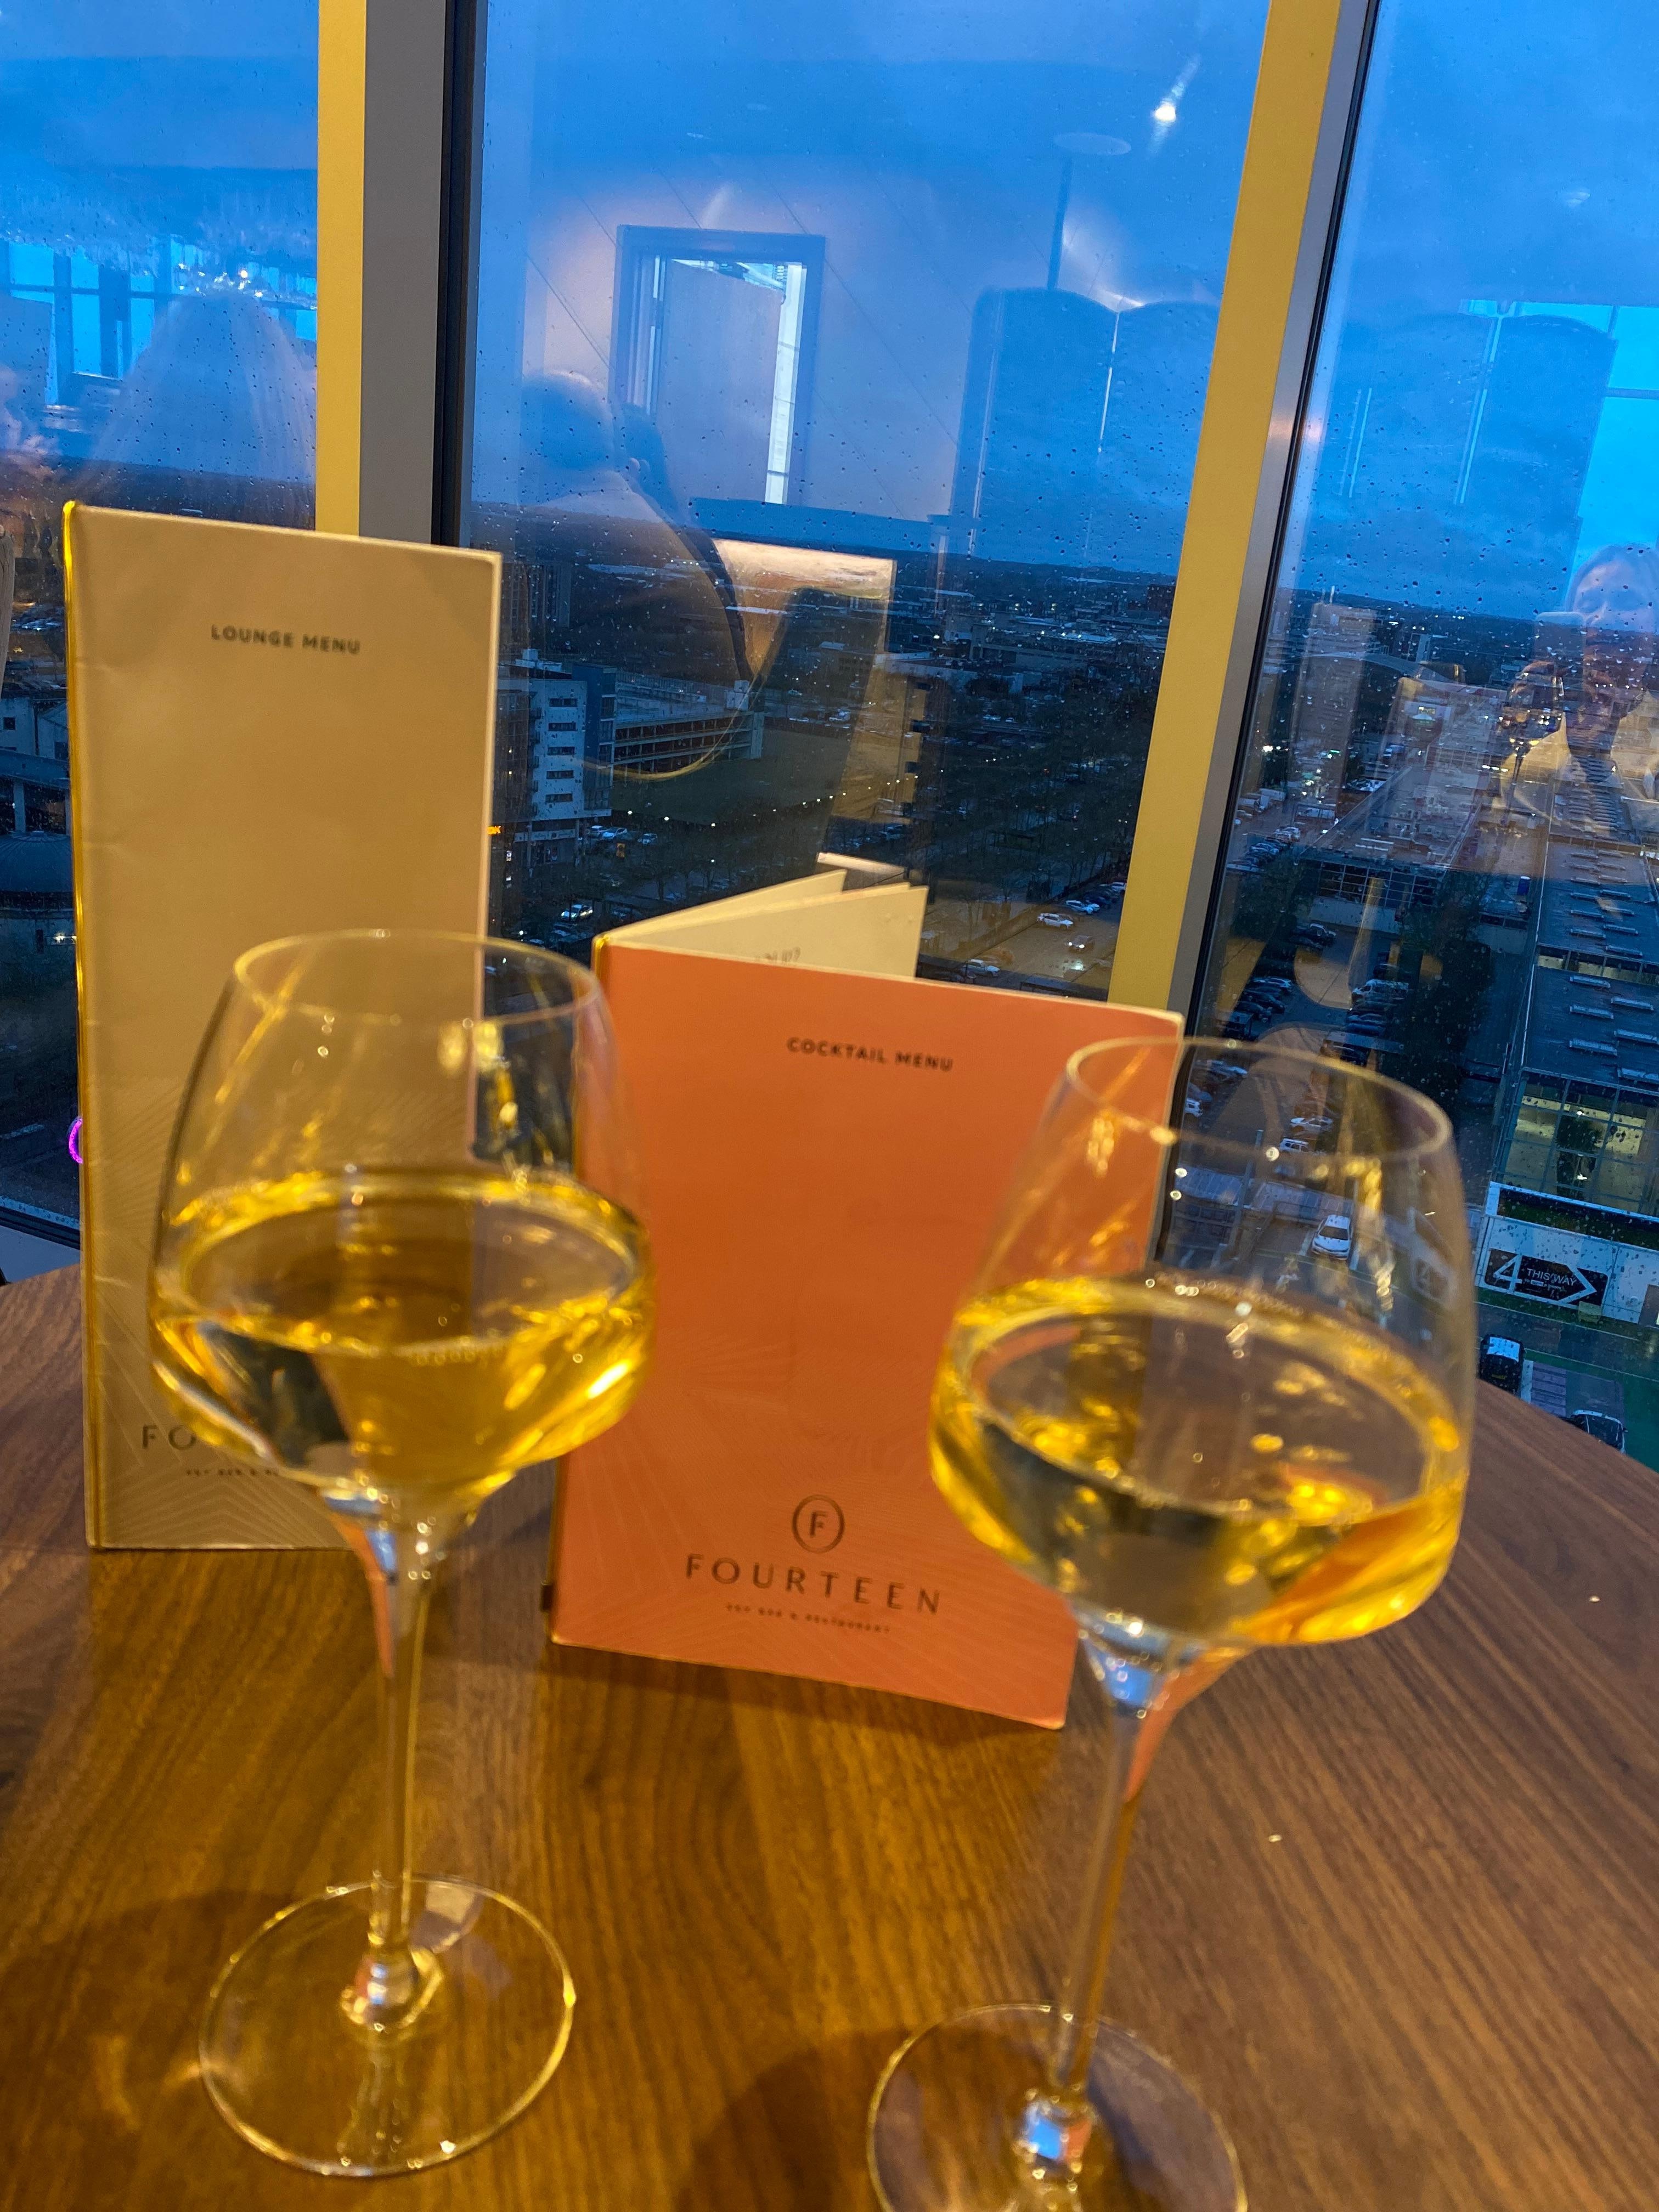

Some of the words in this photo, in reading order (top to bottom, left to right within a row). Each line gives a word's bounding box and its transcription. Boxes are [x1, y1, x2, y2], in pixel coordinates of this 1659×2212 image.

[211, 624, 294, 648] LOUNGE
[303, 634, 360, 654] MENU
[786, 1036, 887, 1064] COCKTAIL
[895, 1050, 953, 1072] MENU
[1527, 1268, 1550, 1280] THIS
[1553, 1273, 1577, 1286] WAY
[809, 1510, 827, 1539] F
[686, 1553, 940, 1615] FOURTEEN
